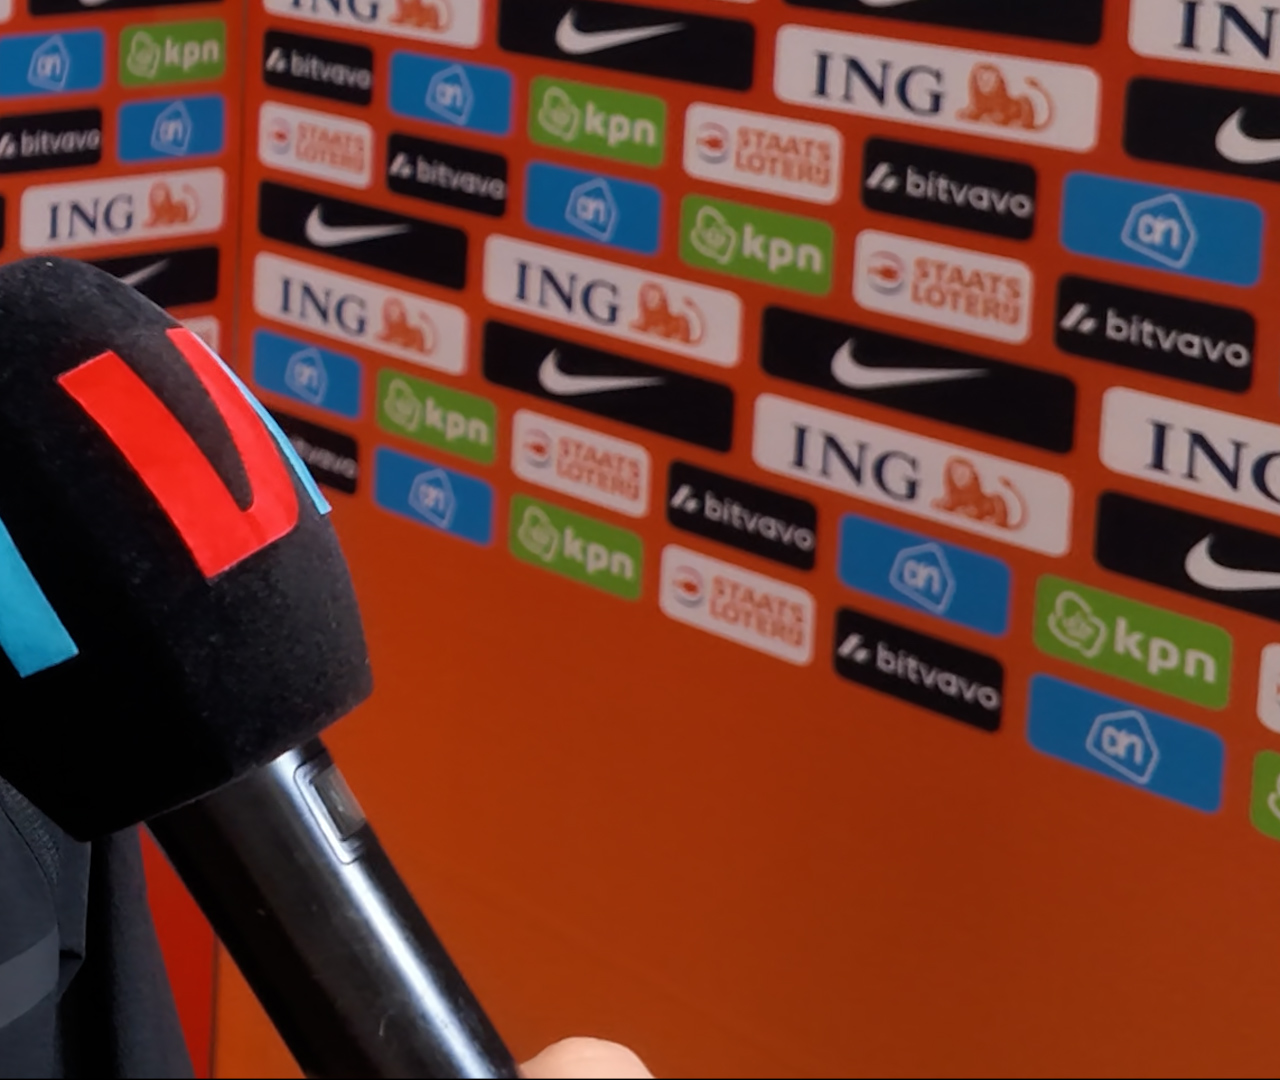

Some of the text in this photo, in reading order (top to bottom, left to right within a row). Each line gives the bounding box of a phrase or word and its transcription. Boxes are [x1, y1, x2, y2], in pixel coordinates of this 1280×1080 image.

[164, 36, 219, 67] kpn
[291, 50, 372, 89] bitvavo
[813, 51, 944, 115] ING
[21, 130, 100, 156] bitvavo
[584, 103, 656, 146] kpn
[417, 157, 507, 199] bitvavo
[906, 167, 1032, 217] bitvavo
[49, 195, 132, 239] ING
[742, 224, 822, 272] kpn
[281, 277, 365, 335] ING
[516, 260, 618, 325] ING
[1106, 309, 1249, 367] bitvavo
[426, 400, 488, 446] kpn
[793, 423, 920, 501] ING
[705, 492, 814, 550] bitvavo
[562, 527, 633, 579] kpn
[877, 642, 999, 709] bitvavo
[1114, 617, 1216, 683] kpn
